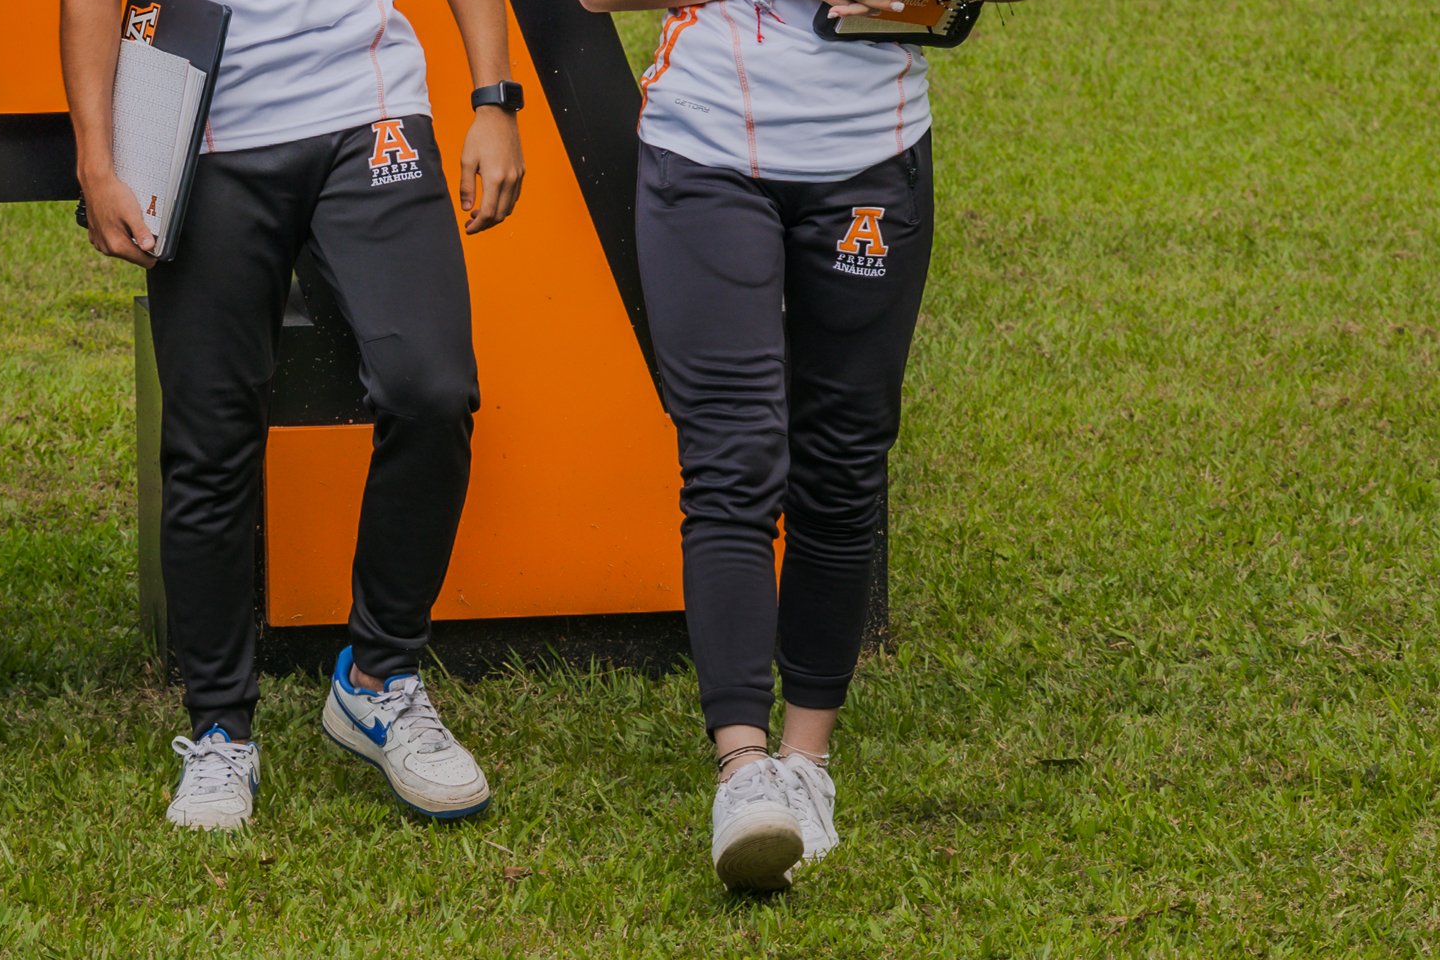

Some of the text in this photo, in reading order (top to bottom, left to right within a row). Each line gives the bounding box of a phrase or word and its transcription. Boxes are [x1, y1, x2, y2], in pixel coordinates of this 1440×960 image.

[368, 119, 420, 170] A
[371, 161, 419, 178] PREPA
[836, 206, 890, 257] A
[837, 253, 885, 268] PREPA
